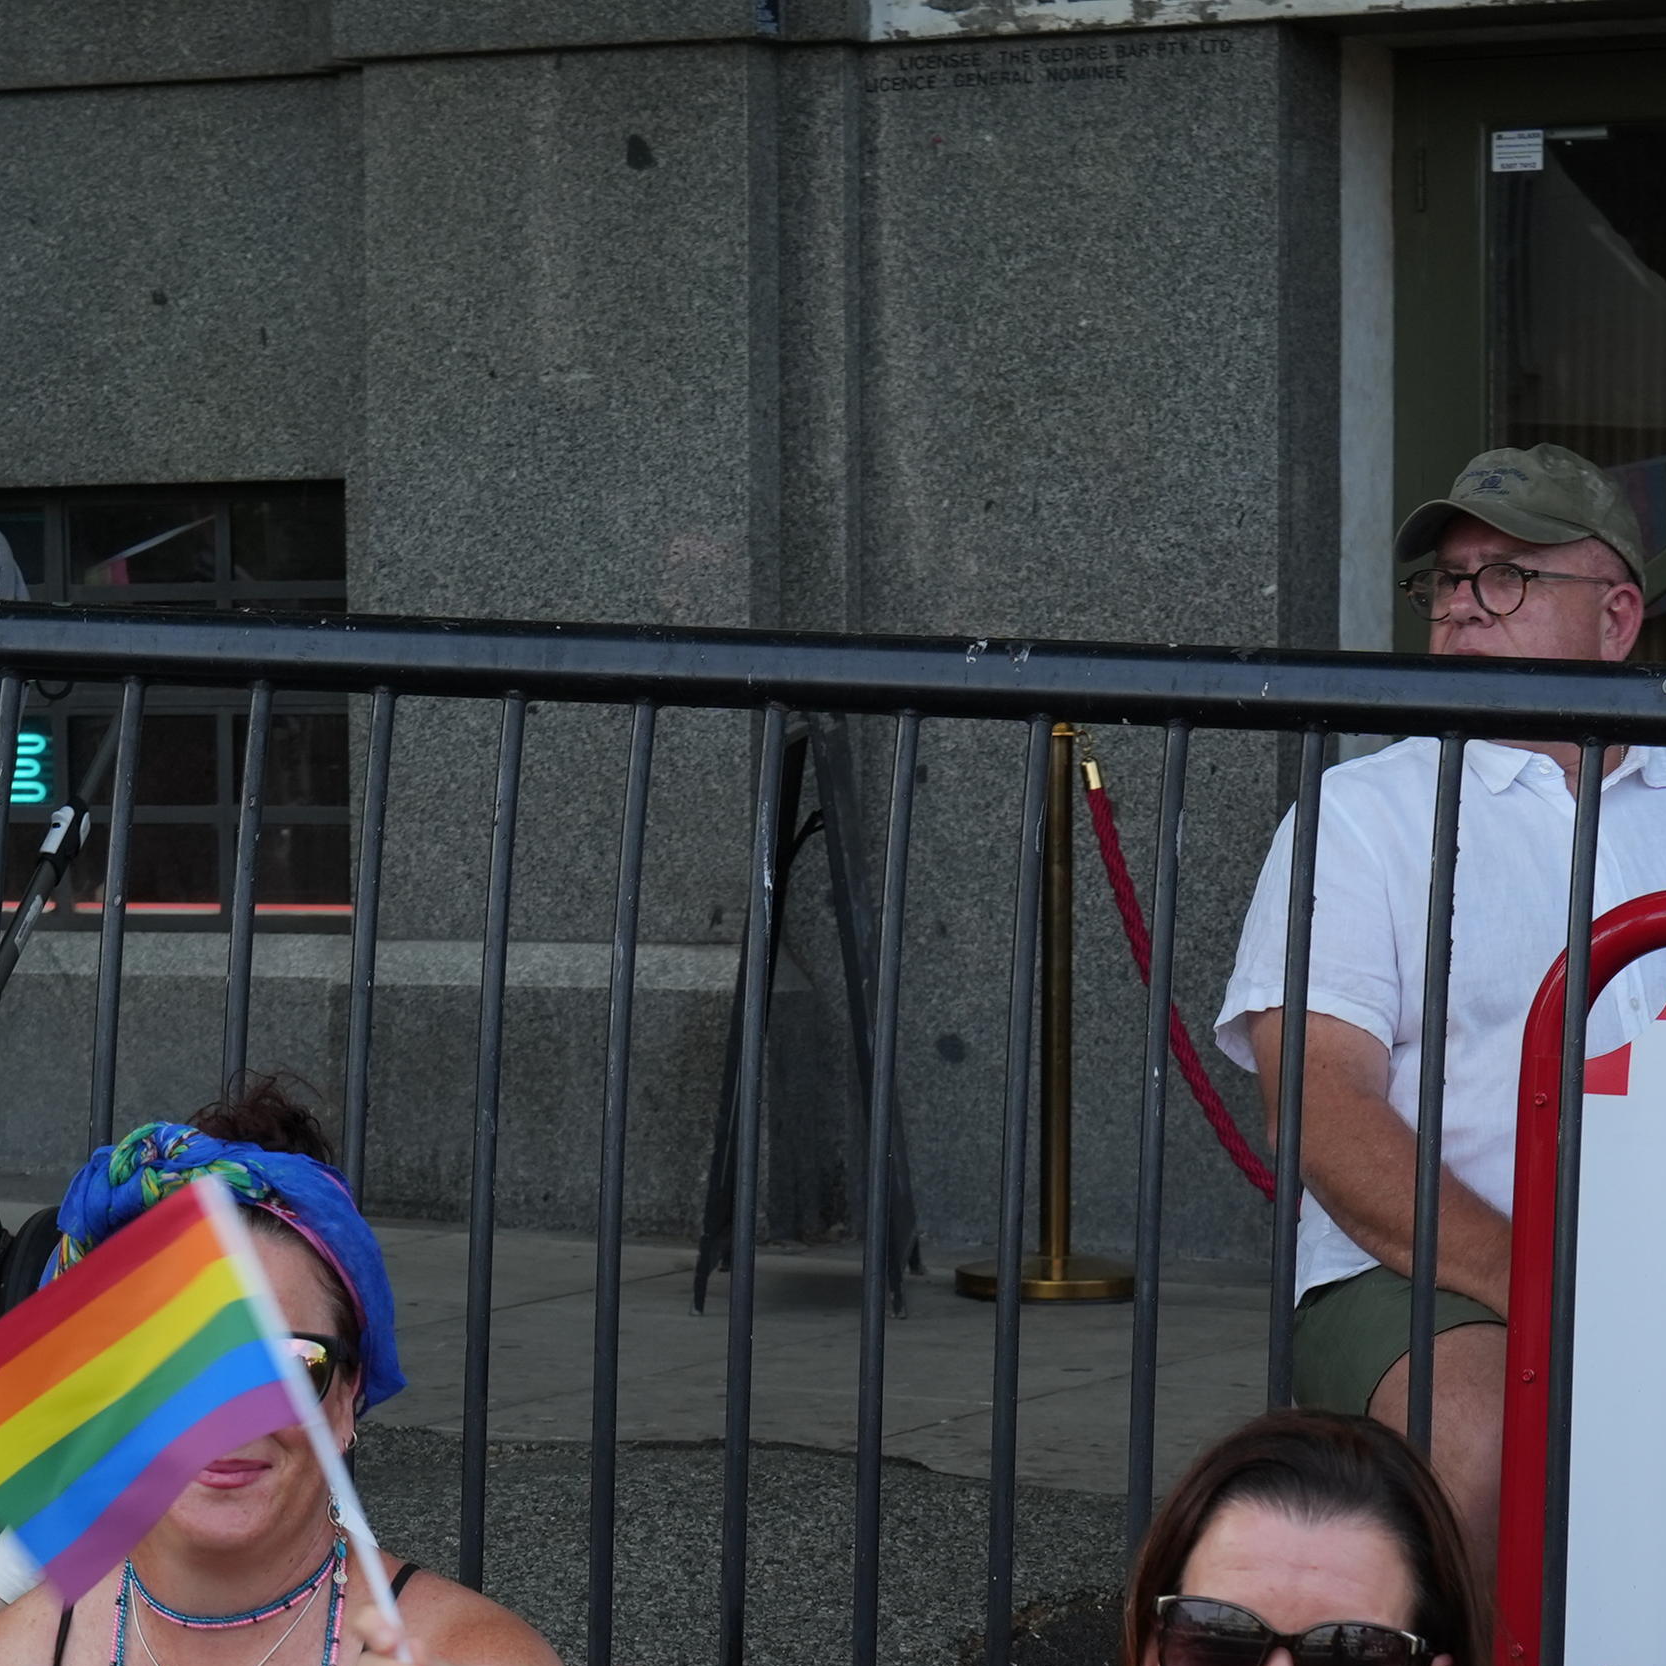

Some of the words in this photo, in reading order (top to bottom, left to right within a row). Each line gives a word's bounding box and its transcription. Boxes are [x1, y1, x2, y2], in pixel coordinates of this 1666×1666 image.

[999, 50, 1032, 65] THE
[1038, 45, 1110, 63] GEORGE
[1115, 42, 1150, 59] BAR
[1200, 38, 1232, 54] LTD
[953, 71, 1034, 87] GENERAL
[1046, 65, 1127, 82] NOMINEE
